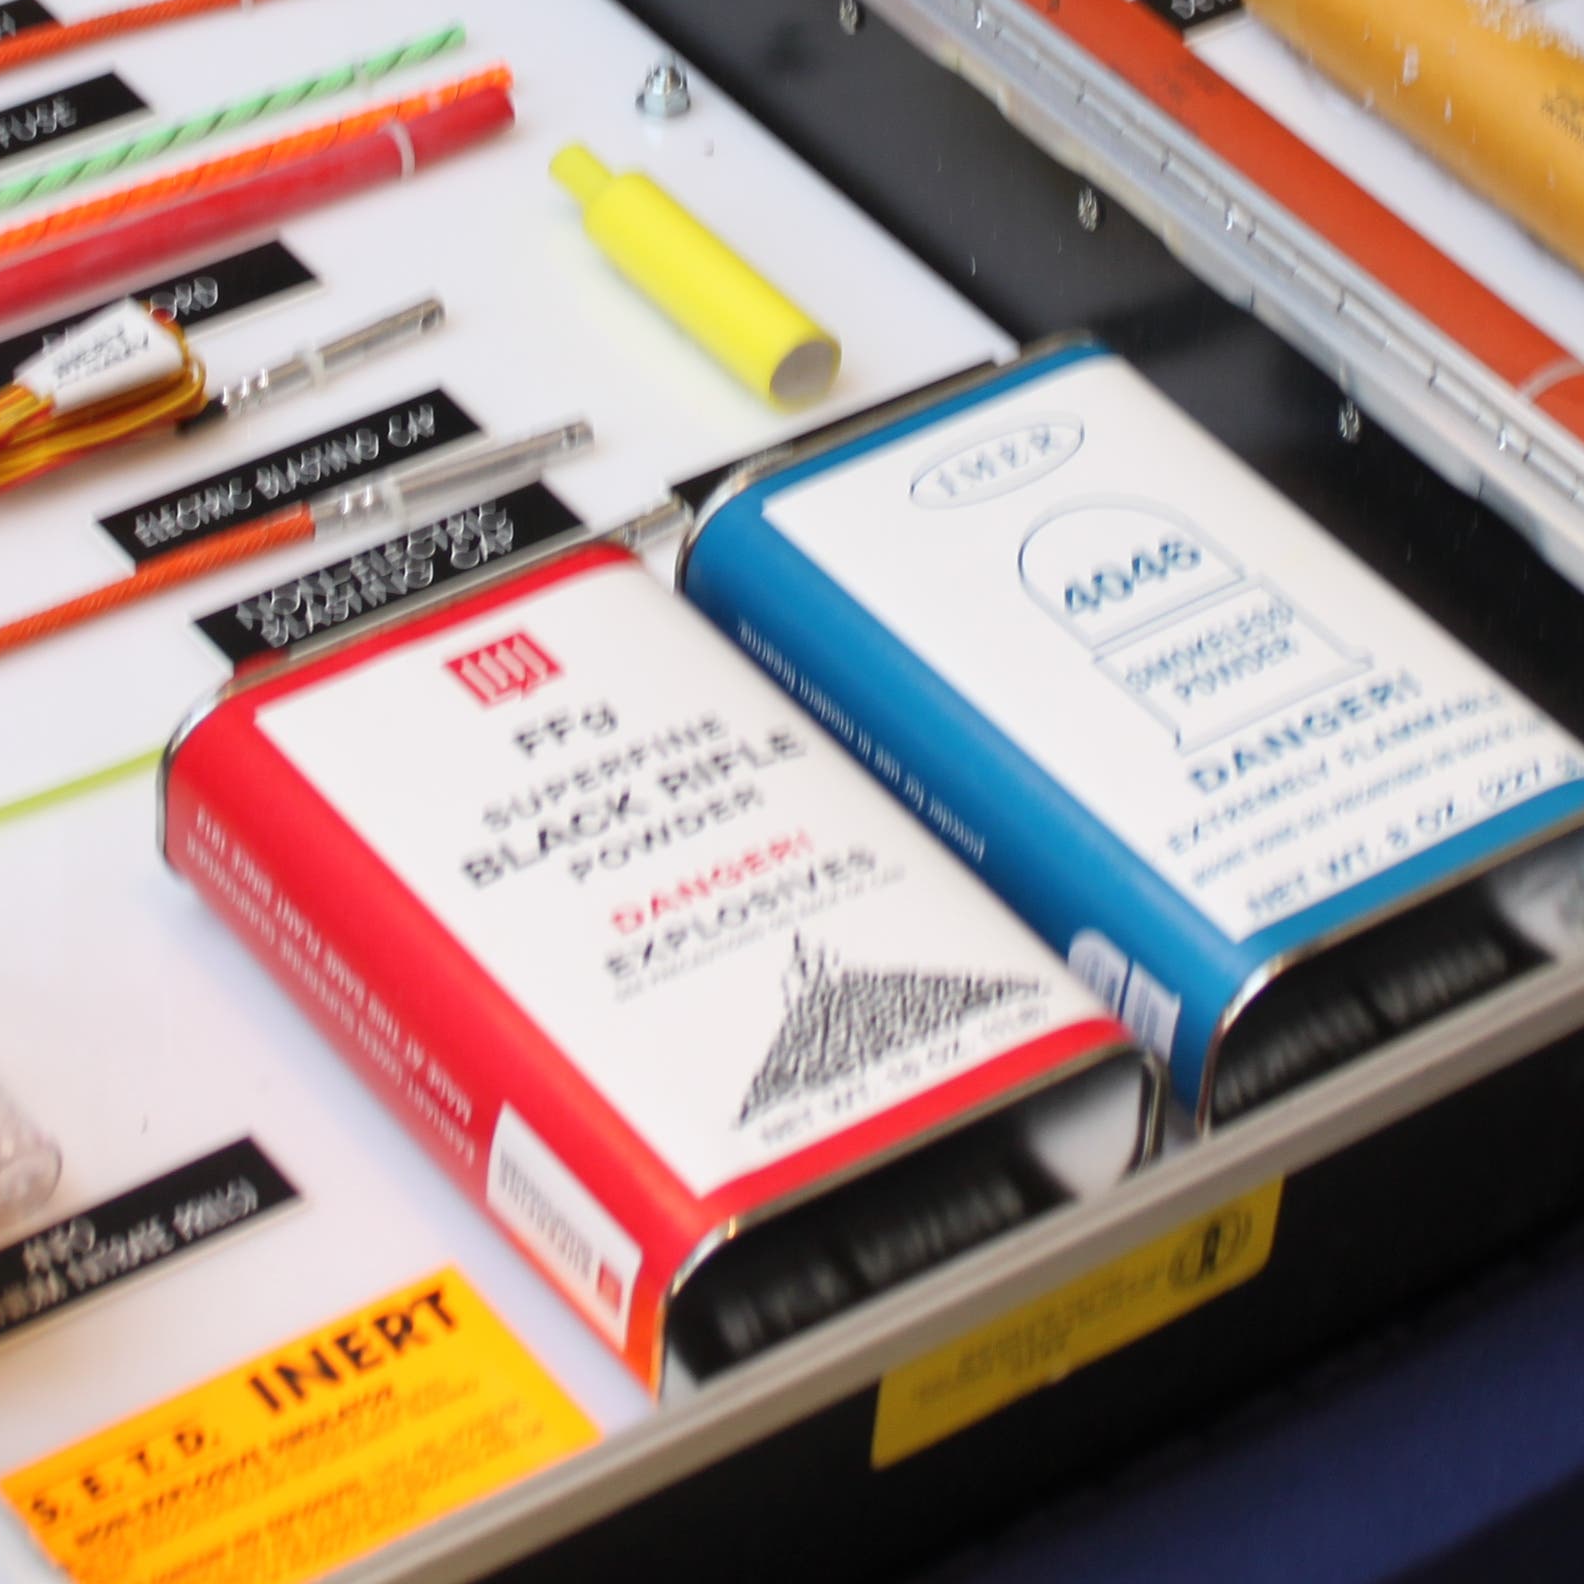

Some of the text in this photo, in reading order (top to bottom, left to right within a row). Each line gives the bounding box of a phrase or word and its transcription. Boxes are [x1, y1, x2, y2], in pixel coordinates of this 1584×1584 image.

[134, 402, 435, 549] ELECTRIC BLASTING CAP
[449, 517, 515, 569] CAP
[480, 712, 728, 834] SUPERFINE
[1186, 665, 1422, 795] DANGER!
[461, 726, 809, 889] BLACK RIFLE
[569, 784, 766, 883] POWDER
[603, 846, 879, 980] EXPLOSIVES
[246, 1283, 461, 1418] INERT
